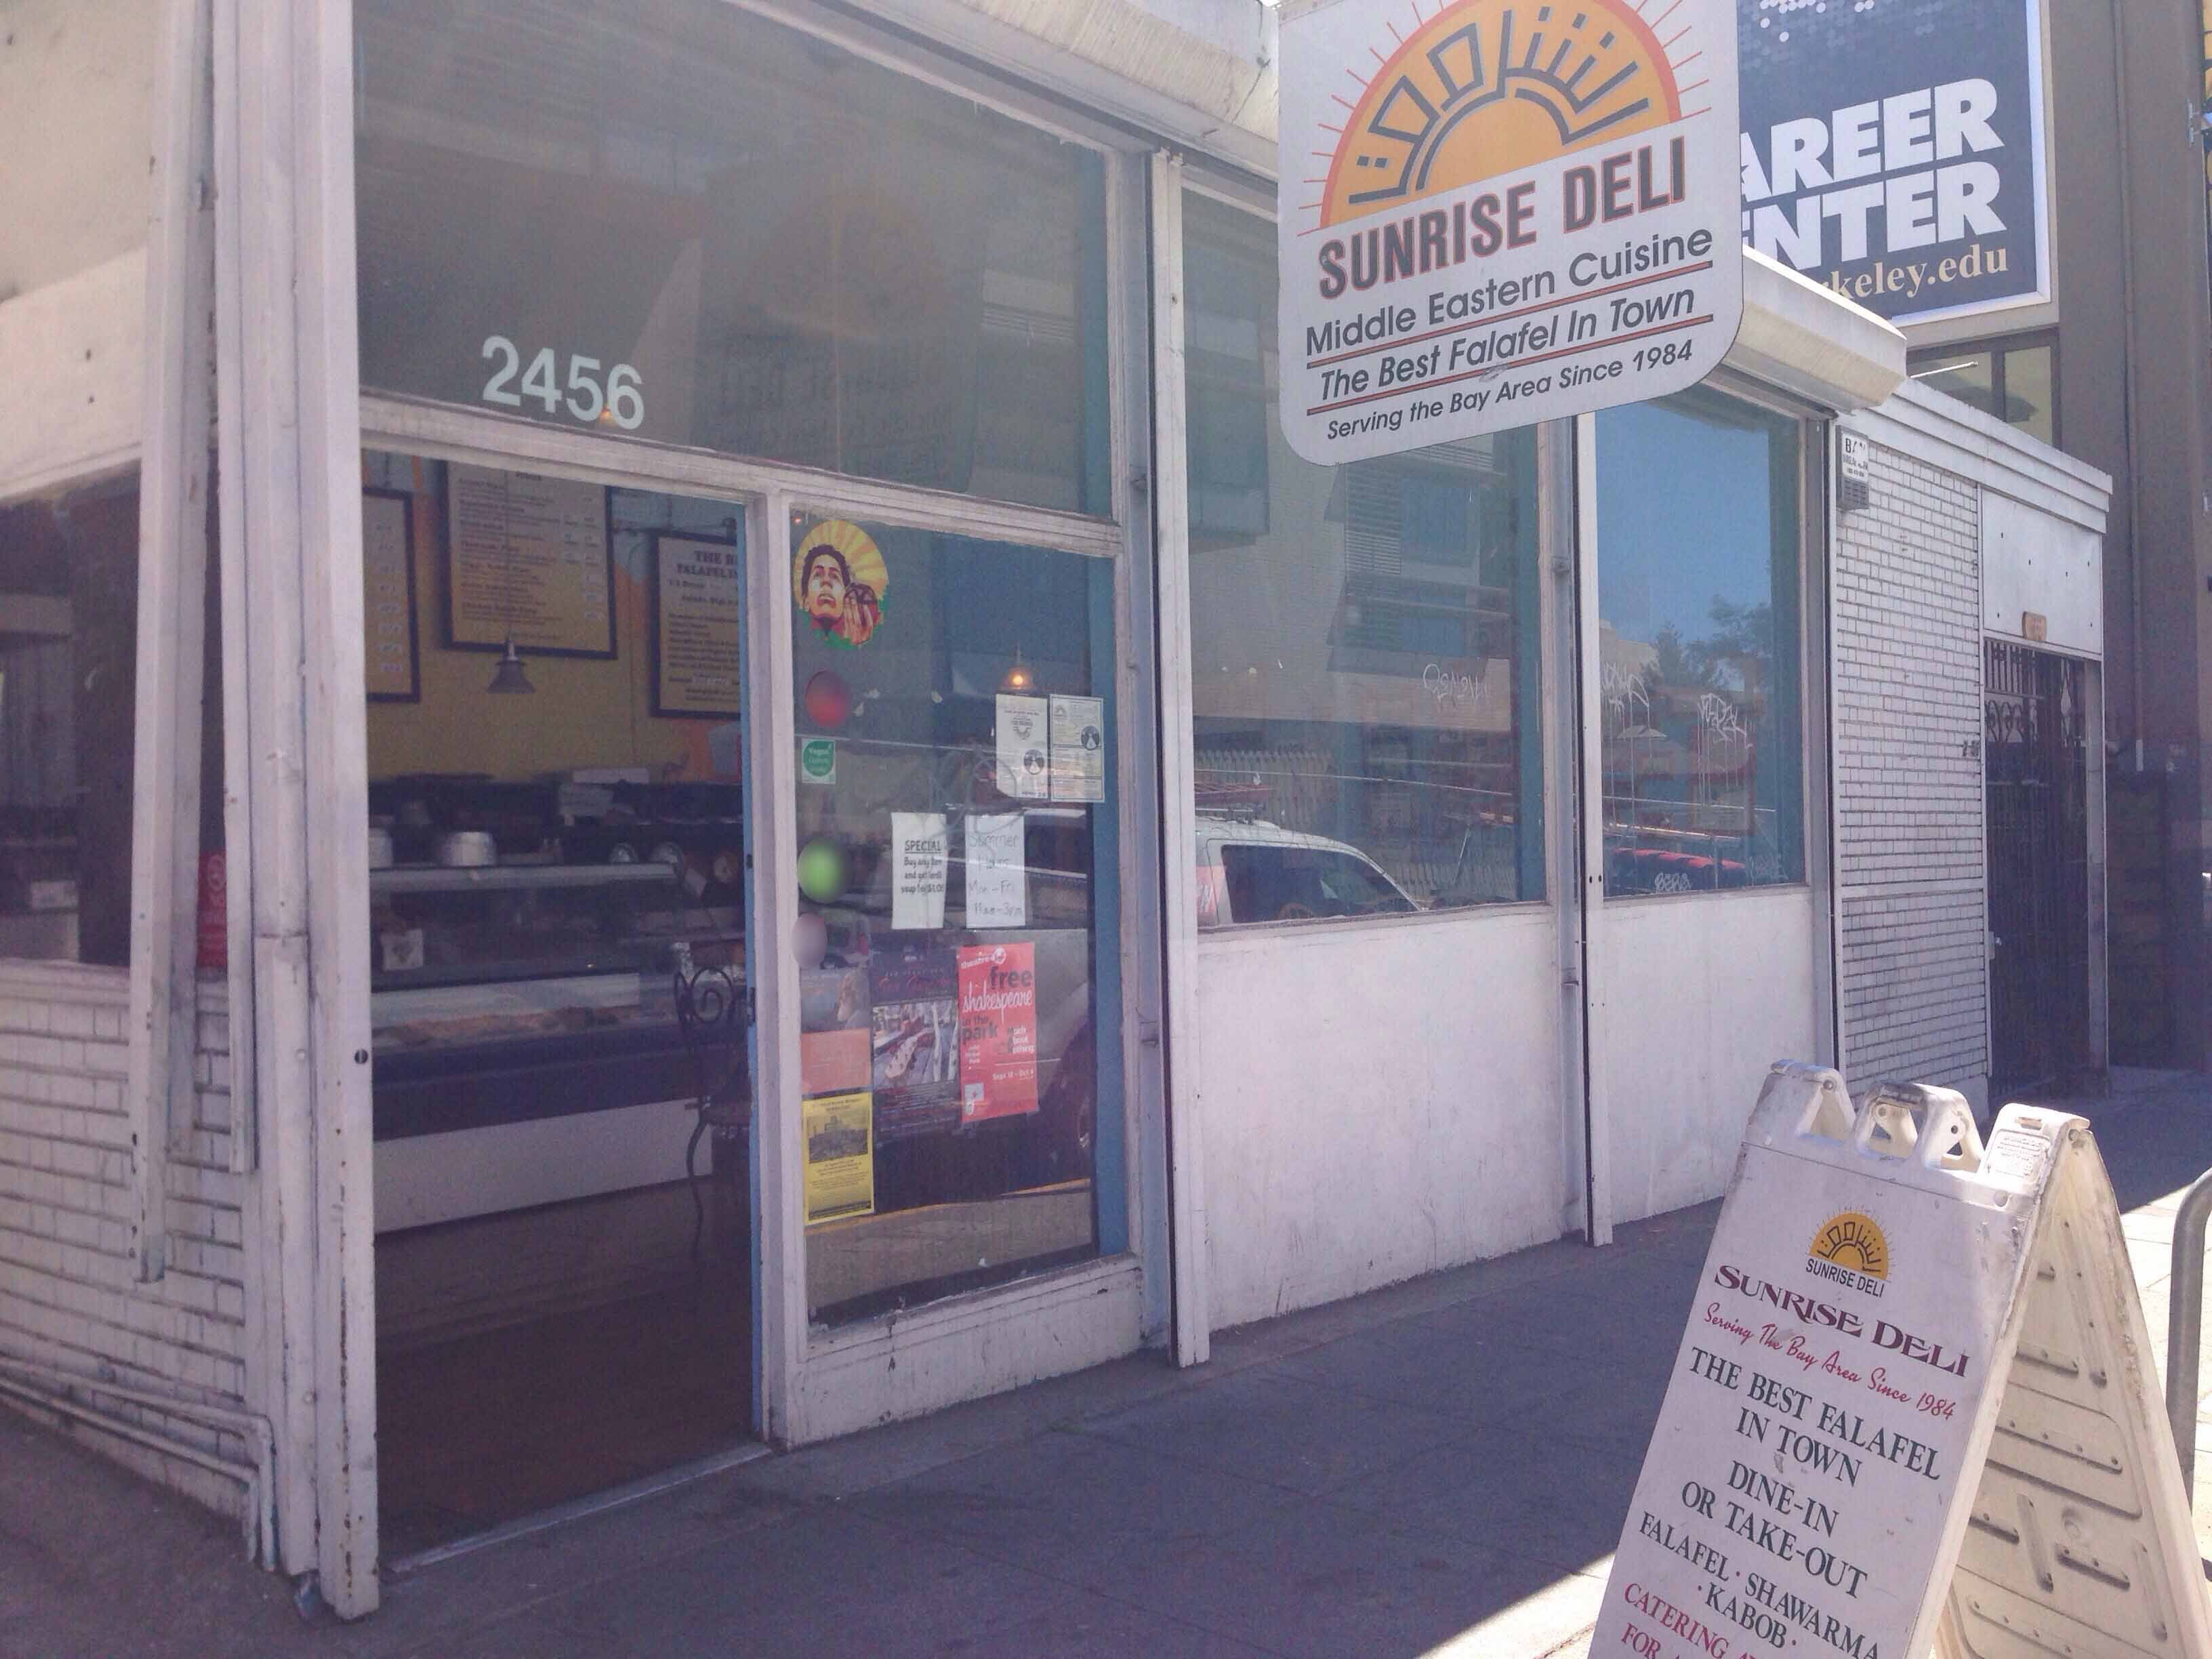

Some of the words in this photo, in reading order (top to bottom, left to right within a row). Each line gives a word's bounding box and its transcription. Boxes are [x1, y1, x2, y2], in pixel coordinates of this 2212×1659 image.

[1318, 180, 1536, 300] SUNRISE
[1562, 136, 1685, 234] DELI
[1742, 161, 2007, 271] NTER
[1307, 305, 1416, 356] Middle
[1429, 270, 1555, 325] Eastern
[1569, 229, 1713, 287] Cuisine
[1821, 244, 2008, 299] keley.edu
[482, 335, 645, 430] 2456
[1321, 368, 1369, 400] The
[1378, 344, 1441, 388] Best
[1448, 314, 1559, 371] Falafel
[1567, 310, 1597, 342] In
[1610, 289, 1695, 332] Town
[1327, 409, 1403, 440] Serving
[1410, 401, 1443, 422] the
[1449, 390, 1492, 413] Bay
[1495, 376, 1552, 403] Area
[1558, 360, 1624, 389] Since
[1632, 339, 1693, 372] 1984
[904, 840, 942, 852] SPECIAL
[962, 981, 1033, 1025] shakespeare
[989, 966, 1032, 989] free
[962, 1021, 998, 1045] park
[1714, 1265, 1864, 1338] SUNRISE
[1870, 1320, 1971, 1378] DELI
[1805, 1258, 1855, 1288] SUNRISE
[1856, 1278, 1885, 1298] DELI
[1703, 1302, 1753, 1345] Serving
[1760, 1322, 1783, 1351] The
[1786, 1336, 1818, 1372] Bay
[1821, 1350, 1862, 1384] Area
[1867, 1367, 1912, 1404] Since
[1915, 1392, 1957, 1420] 1984
[1689, 1346, 1742, 1391] THE
[1746, 1372, 1812, 1421] BEST
[1816, 1402, 1942, 1481] FALAFEL
[1735, 1406, 1770, 1444] IN
[1776, 1424, 1863, 1488] TOWN
[1681, 1481, 1718, 1519] OR
[1724, 1500, 1868, 1599] TAKE-OUT
[1727, 1460, 1840, 1538] DINE-IN
[1624, 1583, 1730, 1659] CATERING
[1639, 1511, 1730, 1582] FALAFEL
[1744, 1572, 1878, 1659] SHAWARMA
[1704, 1582, 1788, 1650] KABOB
[1620, 1622, 1661, 1659] FOR
